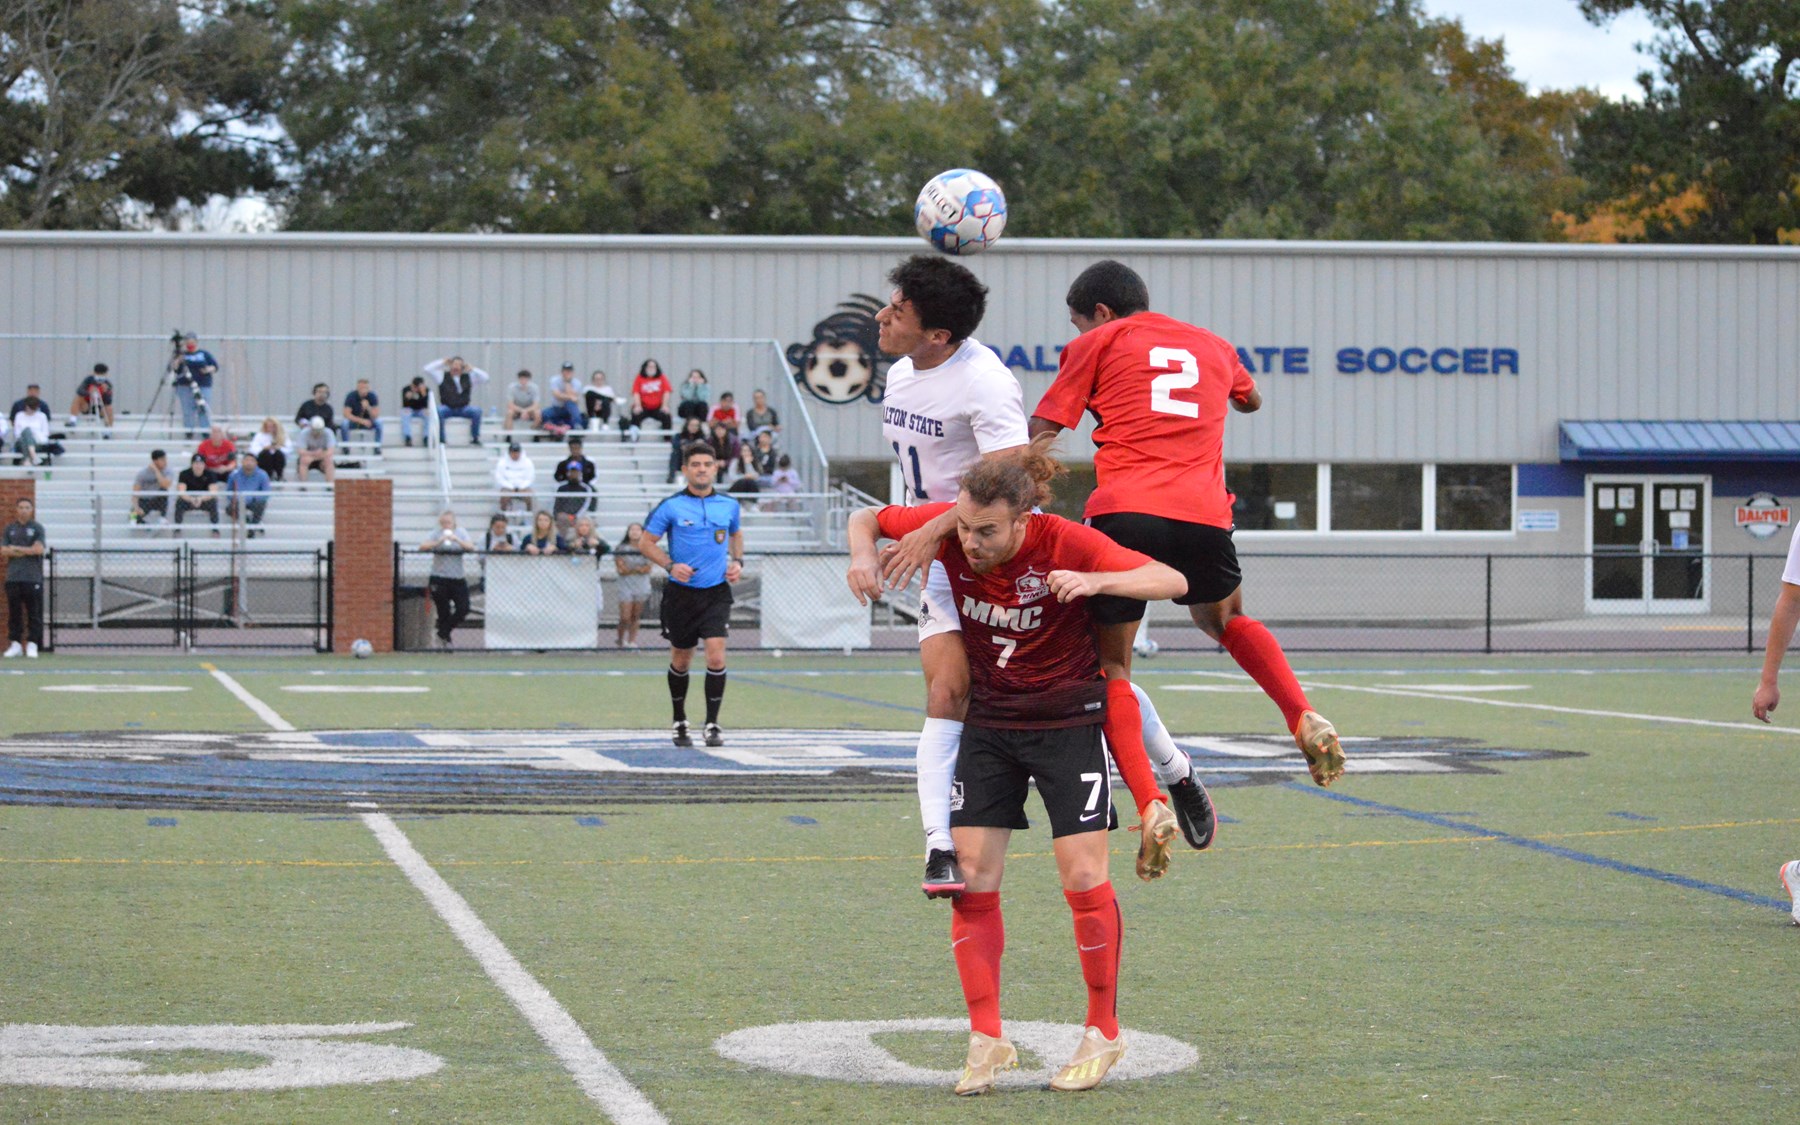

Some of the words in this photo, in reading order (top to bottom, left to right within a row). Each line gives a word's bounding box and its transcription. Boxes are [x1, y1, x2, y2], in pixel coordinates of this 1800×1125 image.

[1337, 347, 1519, 374] SOCCER
[1149, 346, 1199, 419] 2
[909, 413, 945, 438] STATE
[1737, 507, 1789, 523] DALTON
[962, 594, 1043, 632] MMC
[992, 635, 1017, 669] 7
[1080, 772, 1103, 811] 7
